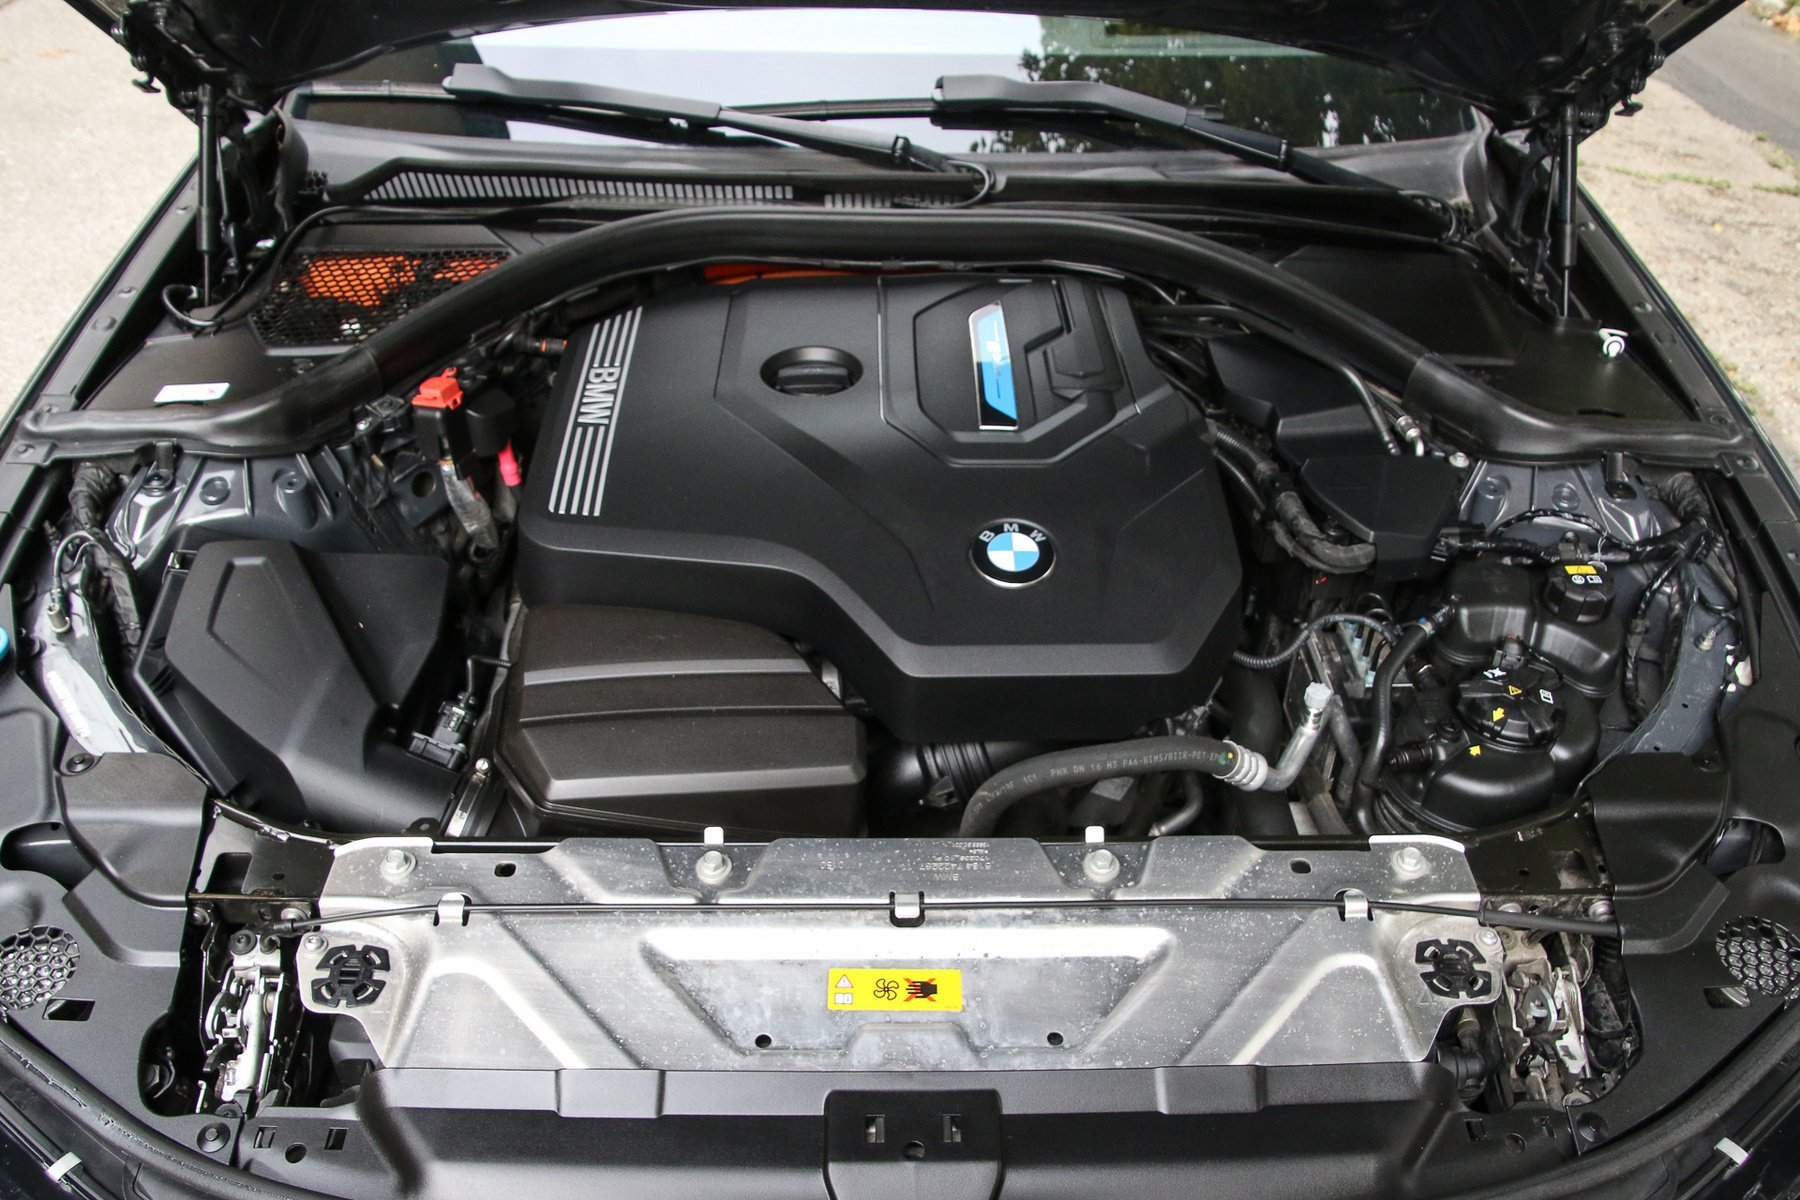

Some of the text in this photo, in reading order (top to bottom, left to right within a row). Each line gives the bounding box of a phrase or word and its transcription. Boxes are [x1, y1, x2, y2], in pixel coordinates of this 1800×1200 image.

[577, 367, 621, 424] BMW
[978, 523, 1047, 543] BMW
[1050, 766, 1068, 777] PHX
[1073, 763, 1085, 774] DN
